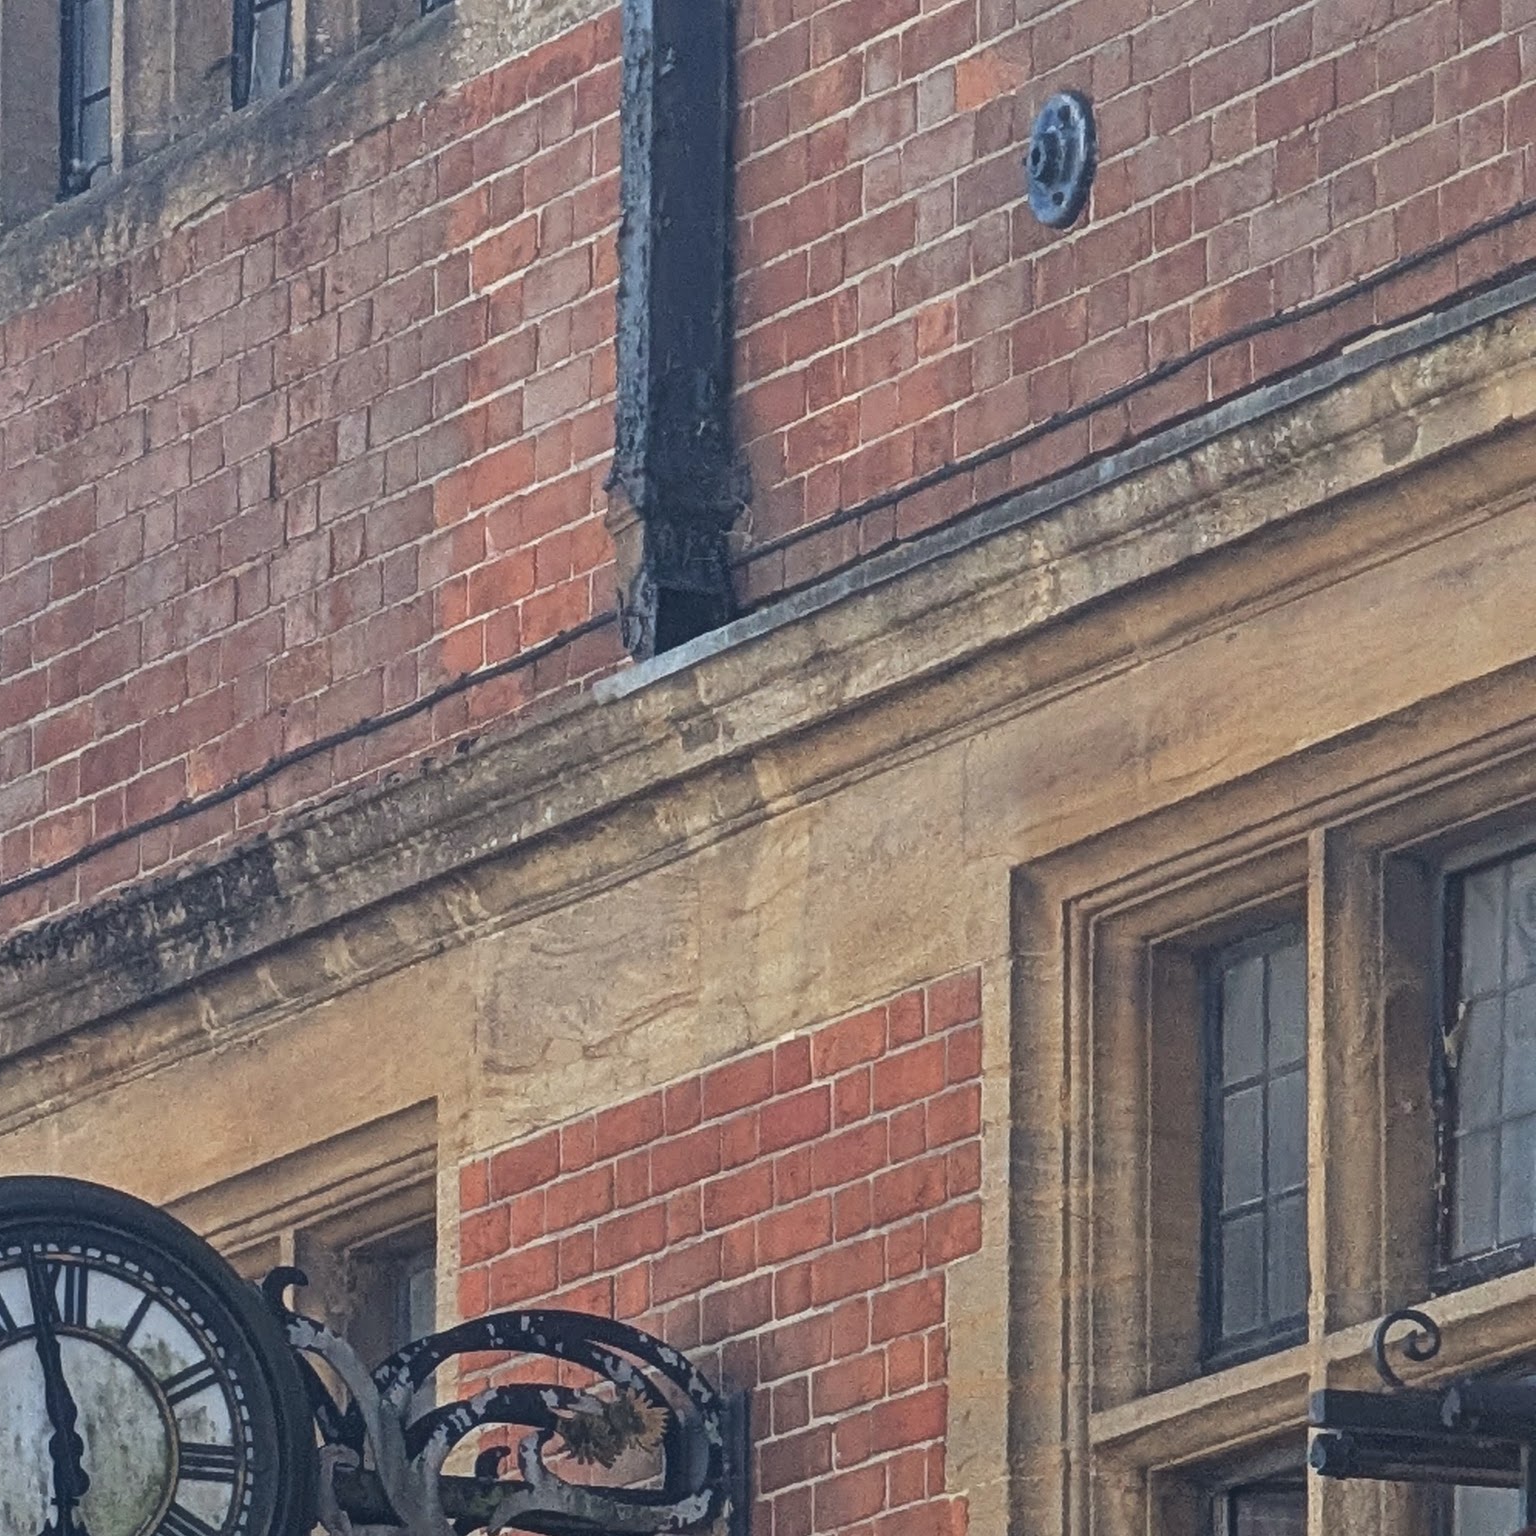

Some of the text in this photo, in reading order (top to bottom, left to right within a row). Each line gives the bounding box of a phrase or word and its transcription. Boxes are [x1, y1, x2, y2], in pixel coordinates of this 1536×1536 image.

[120, 1292, 155, 1347] I
[159, 1357, 221, 1407] II
[180, 1441, 236, 1483] III
